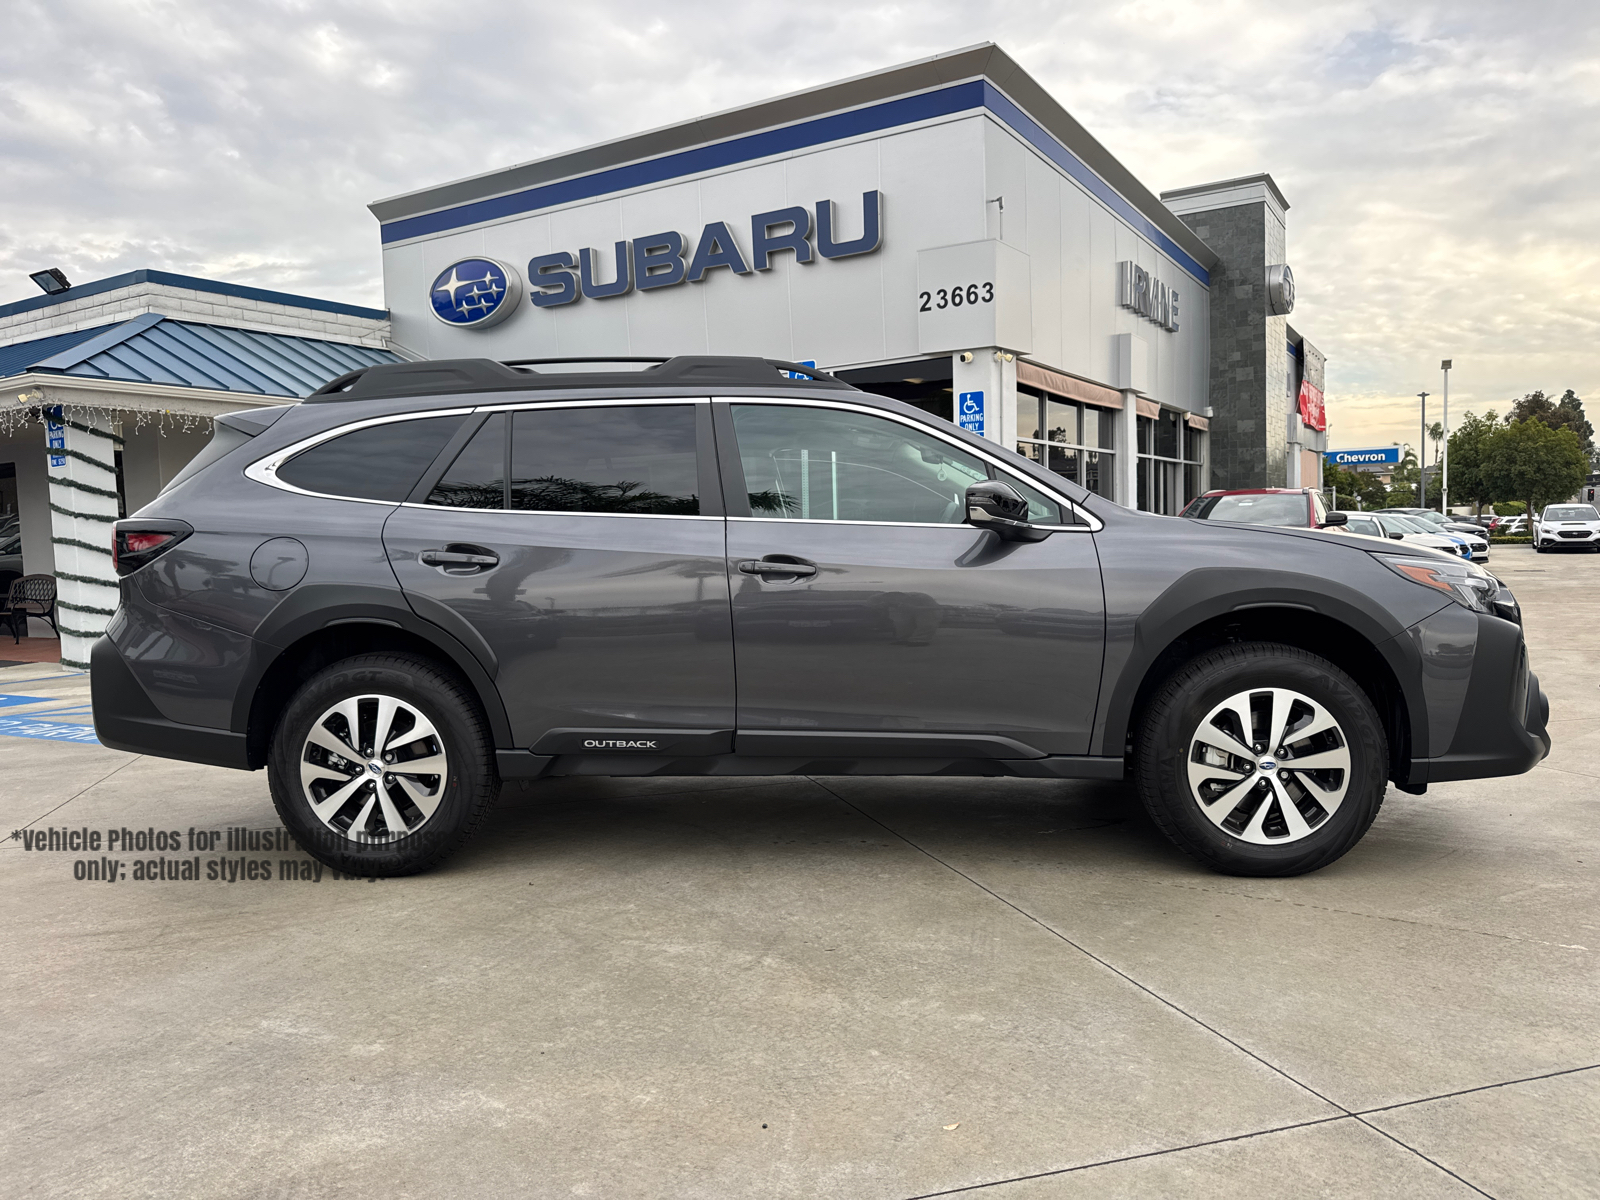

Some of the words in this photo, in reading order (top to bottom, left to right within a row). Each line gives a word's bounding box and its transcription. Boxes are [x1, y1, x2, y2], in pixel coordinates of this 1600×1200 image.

[528, 189, 883, 307] SUBARU
[919, 282, 994, 312] 23663
[1120, 260, 1179, 332] IRVINE
[960, 413, 983, 422] PARKING
[1336, 453, 1386, 463] Chevron
[584, 740, 657, 748] OUTBACK
